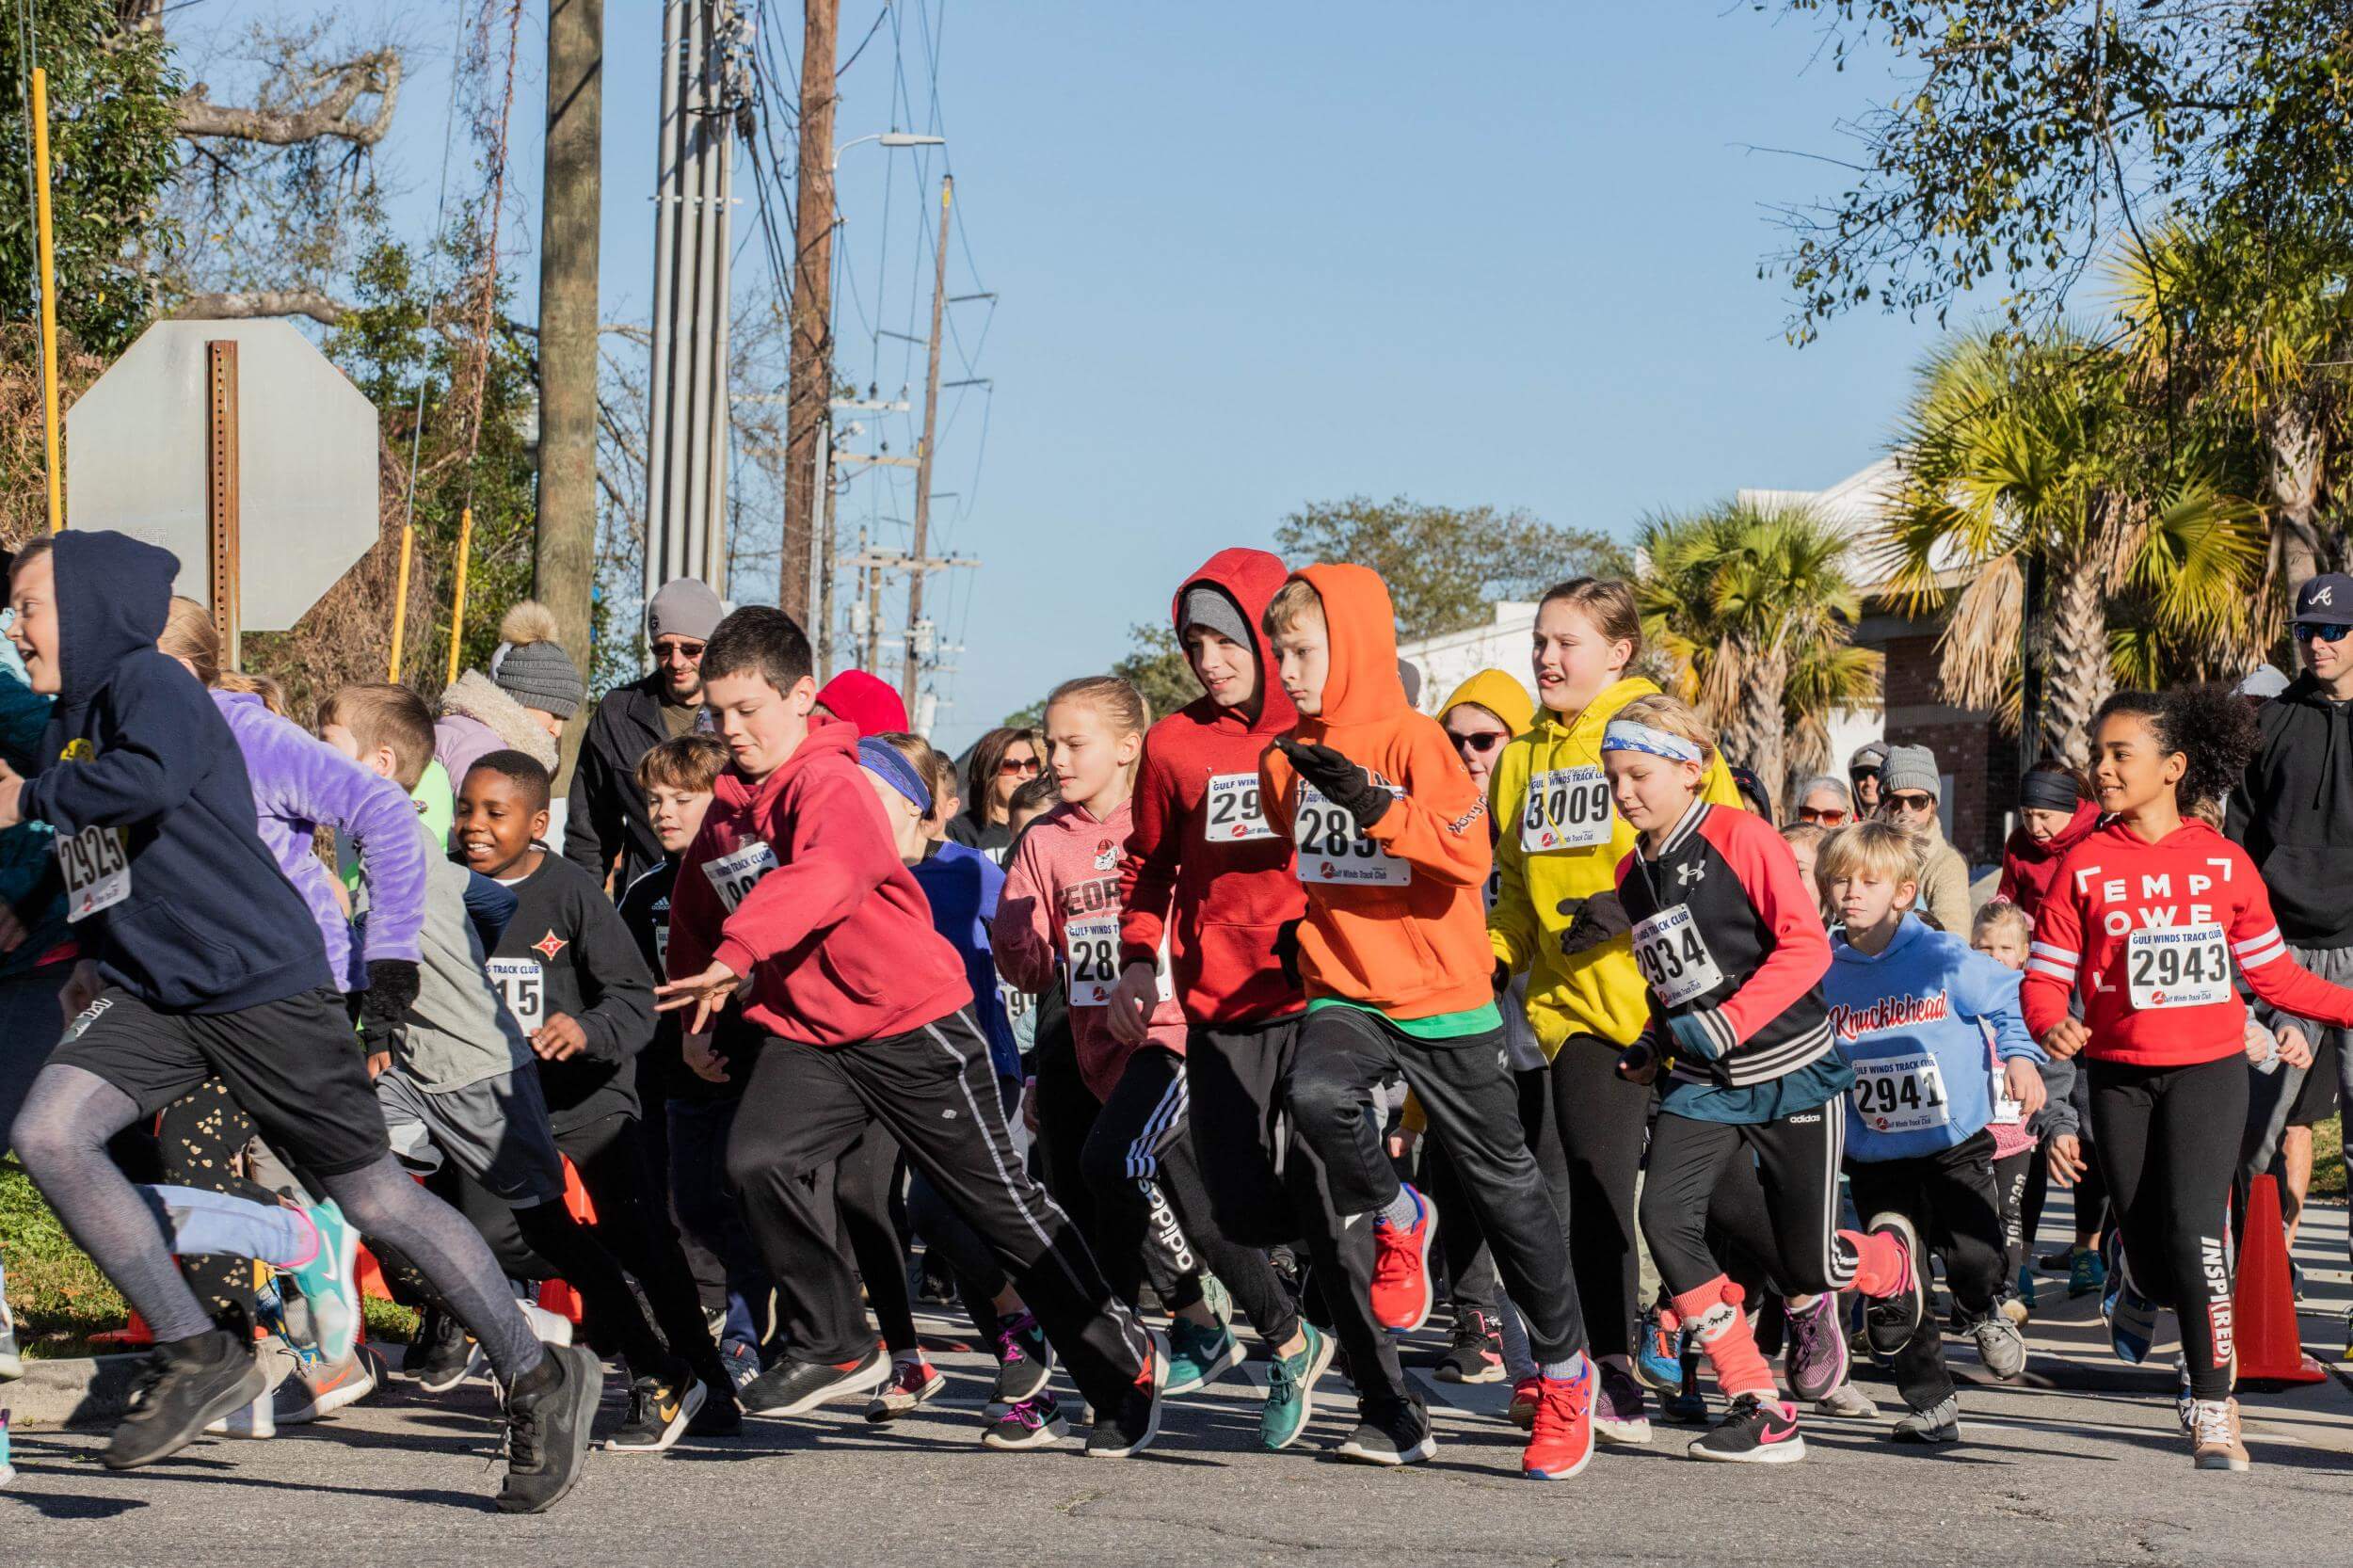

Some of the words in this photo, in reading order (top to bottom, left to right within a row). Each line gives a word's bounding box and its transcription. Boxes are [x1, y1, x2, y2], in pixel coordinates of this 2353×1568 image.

[1213, 781, 1235, 791] GULF
[1549, 775, 1570, 786] WINDS
[1573, 771, 1593, 783] TRACK
[1527, 783, 1609, 830] 3009
[62, 826, 124, 892] 2925
[1069, 925, 1088, 936] GULF
[1091, 925, 1112, 935] WINDS
[1648, 921, 1671, 937] TRACK
[1671, 910, 1689, 925] CLUB
[2133, 934, 2152, 945] GULF
[2154, 932, 2181, 944] WINDS
[2182, 930, 2207, 942] TRACK
[2208, 929, 2222, 939] CLUB
[1635, 926, 1706, 987] 2934
[2132, 943, 2227, 986] 2943
[493, 966, 517, 974] TRACK
[520, 965, 539, 974] CLUB
[1869, 1064, 1894, 1074] WINDS
[1896, 1061, 1920, 1072] TRACK
[1855, 1073, 1944, 1114] 2941
[1789, 1114, 1821, 1124] adidas
[1138, 1177, 1193, 1271] adidas
